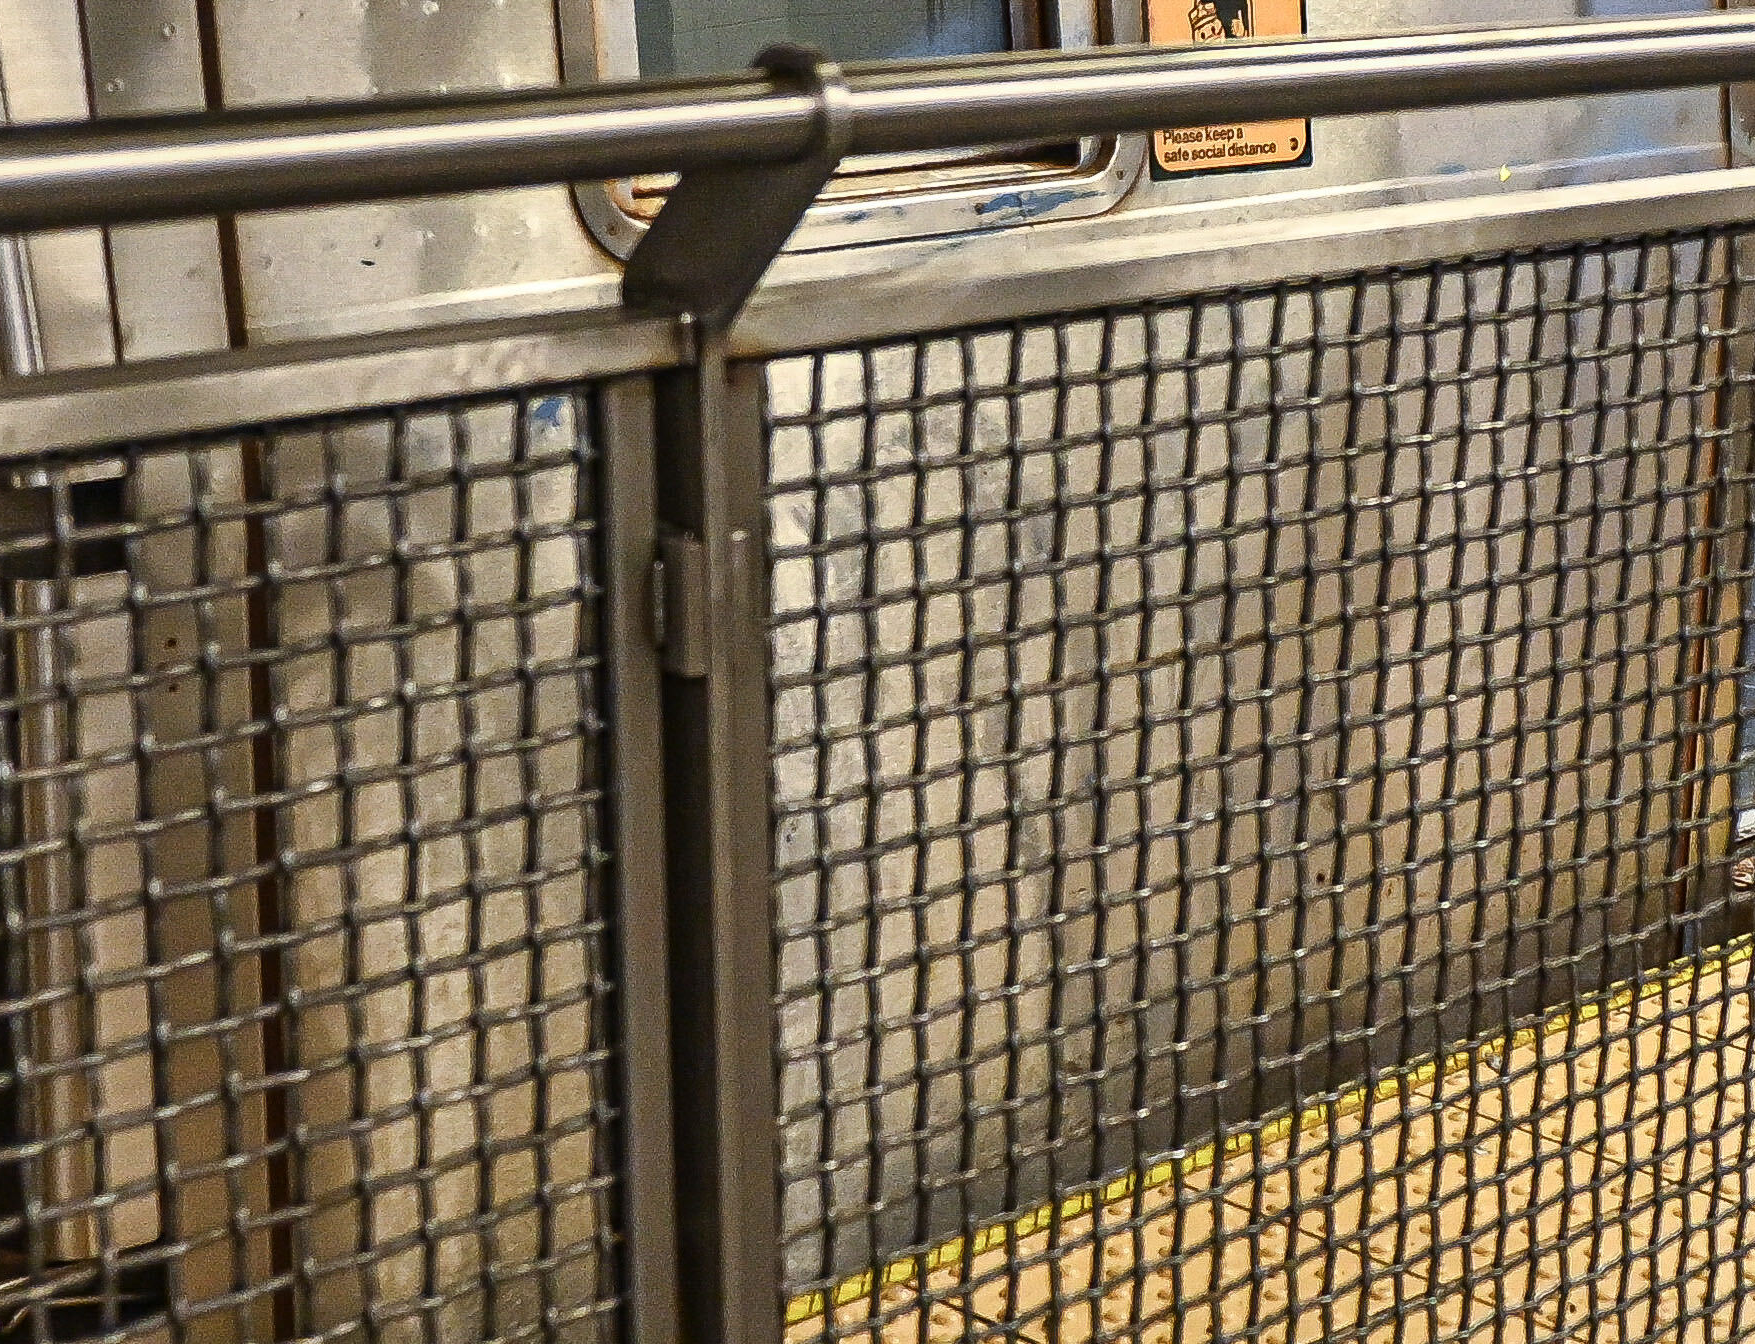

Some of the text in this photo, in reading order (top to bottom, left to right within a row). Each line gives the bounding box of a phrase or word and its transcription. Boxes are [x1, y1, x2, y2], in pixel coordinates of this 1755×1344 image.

[1163, 127, 1244, 146] Please keep a
[1164, 141, 1277, 163] safe social distance
